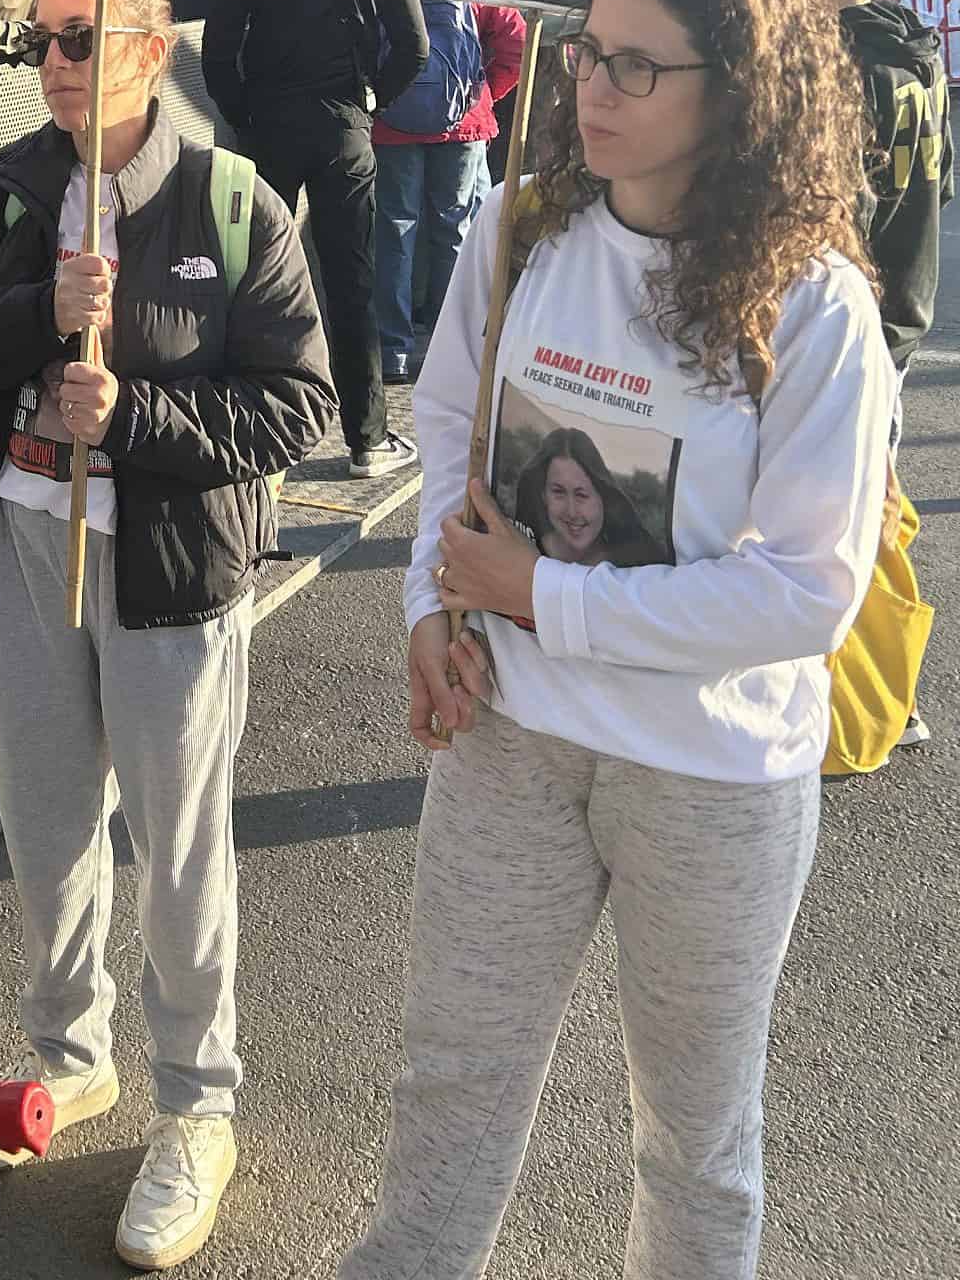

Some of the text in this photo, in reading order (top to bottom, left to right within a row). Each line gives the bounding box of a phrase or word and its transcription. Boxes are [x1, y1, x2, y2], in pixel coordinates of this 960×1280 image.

[182, 256, 200, 265] THE
[171, 264, 201, 273] NORTH
[179, 271, 201, 280] FACE
[534, 345, 584, 375] NAAMA
[583, 363, 619, 387] LEVY
[522, 366, 655, 417] A PEACE SEEKER AND TRIATHLETE
